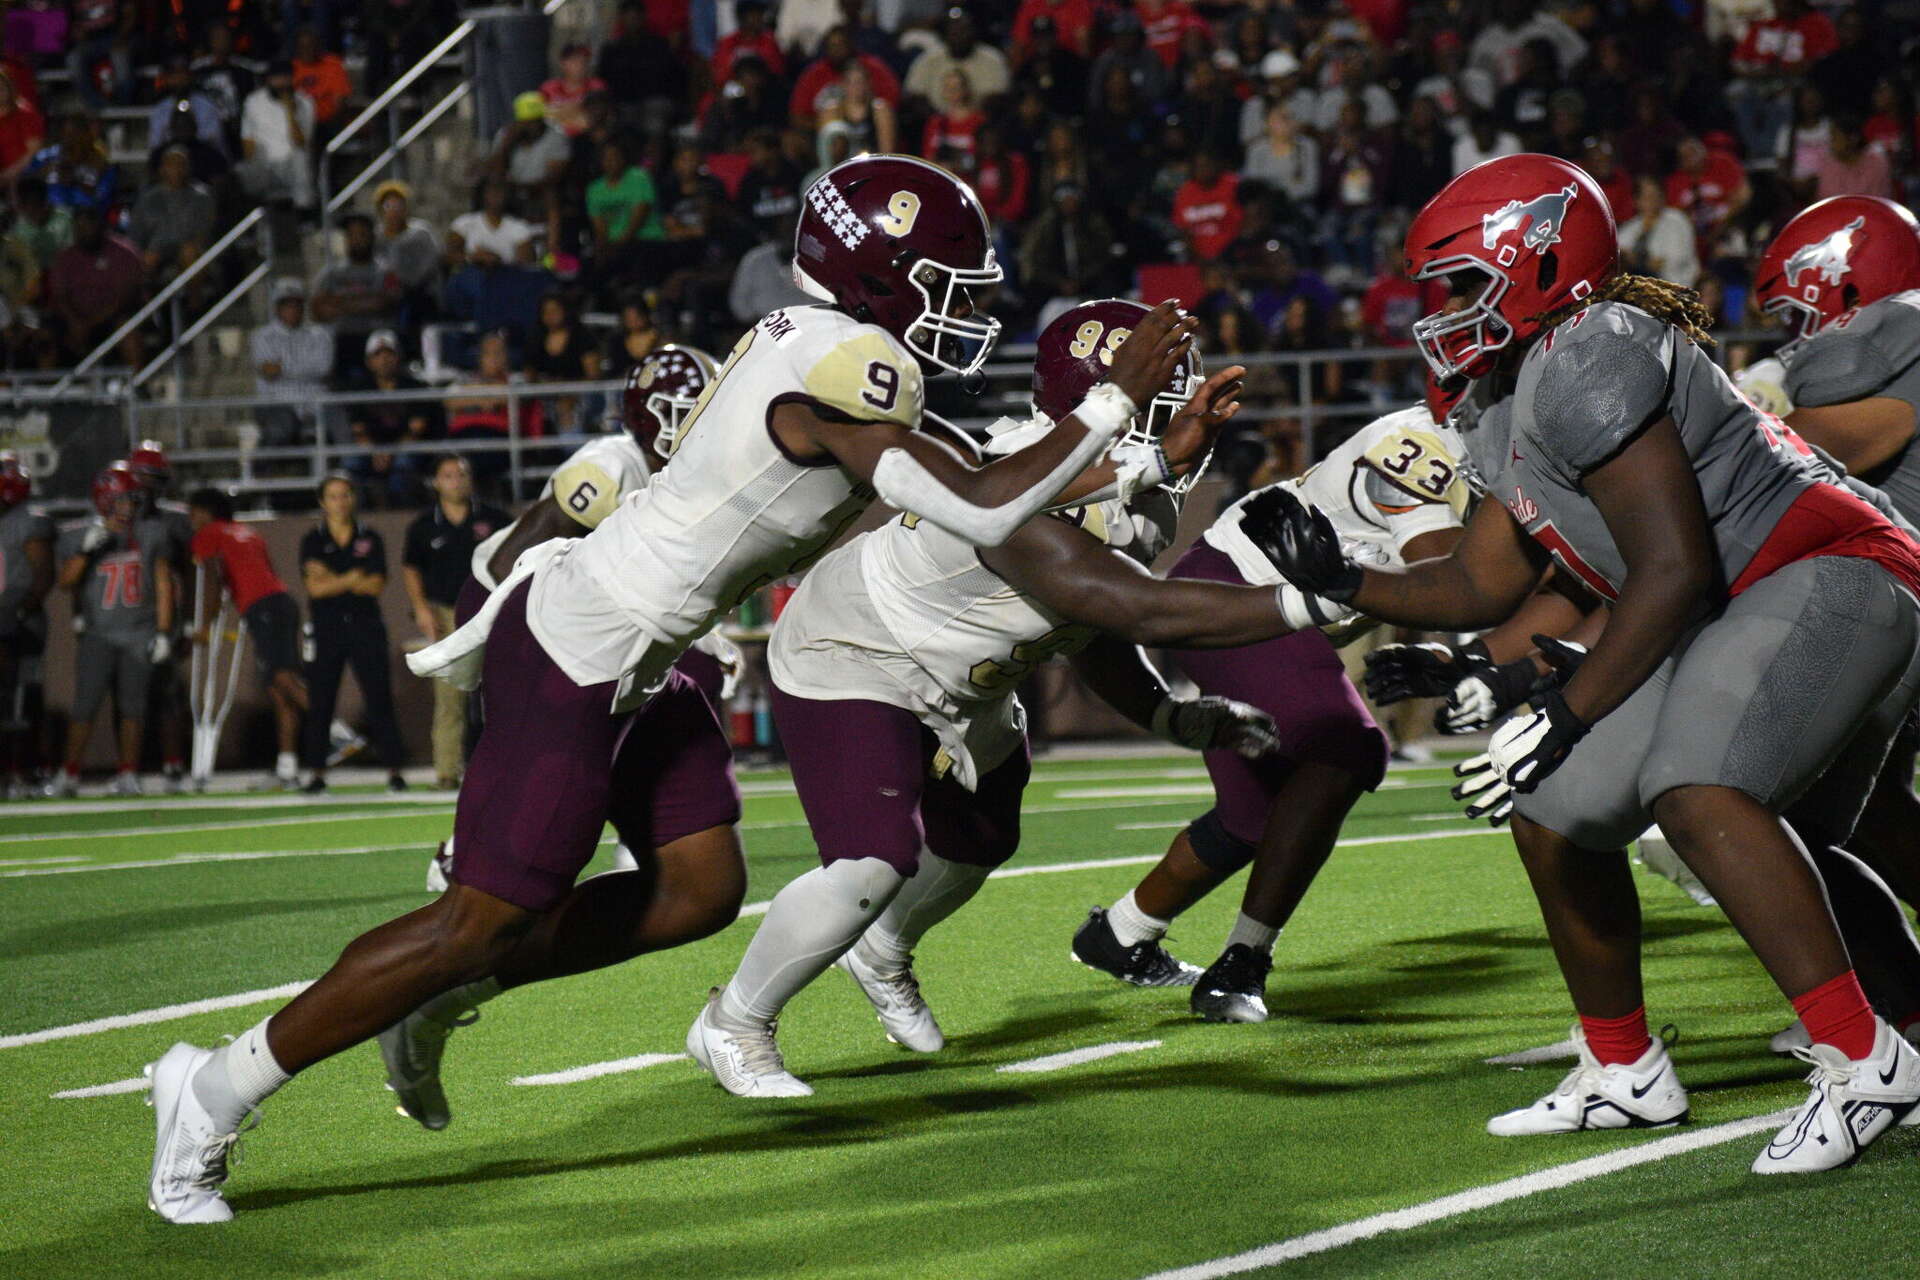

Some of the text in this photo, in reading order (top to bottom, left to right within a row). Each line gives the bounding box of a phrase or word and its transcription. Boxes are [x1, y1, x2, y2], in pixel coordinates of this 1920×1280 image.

[880, 189, 922, 238] 9
[860, 360, 900, 413] 9
[1382, 437, 1456, 496] 33
[568, 480, 599, 514] 6
